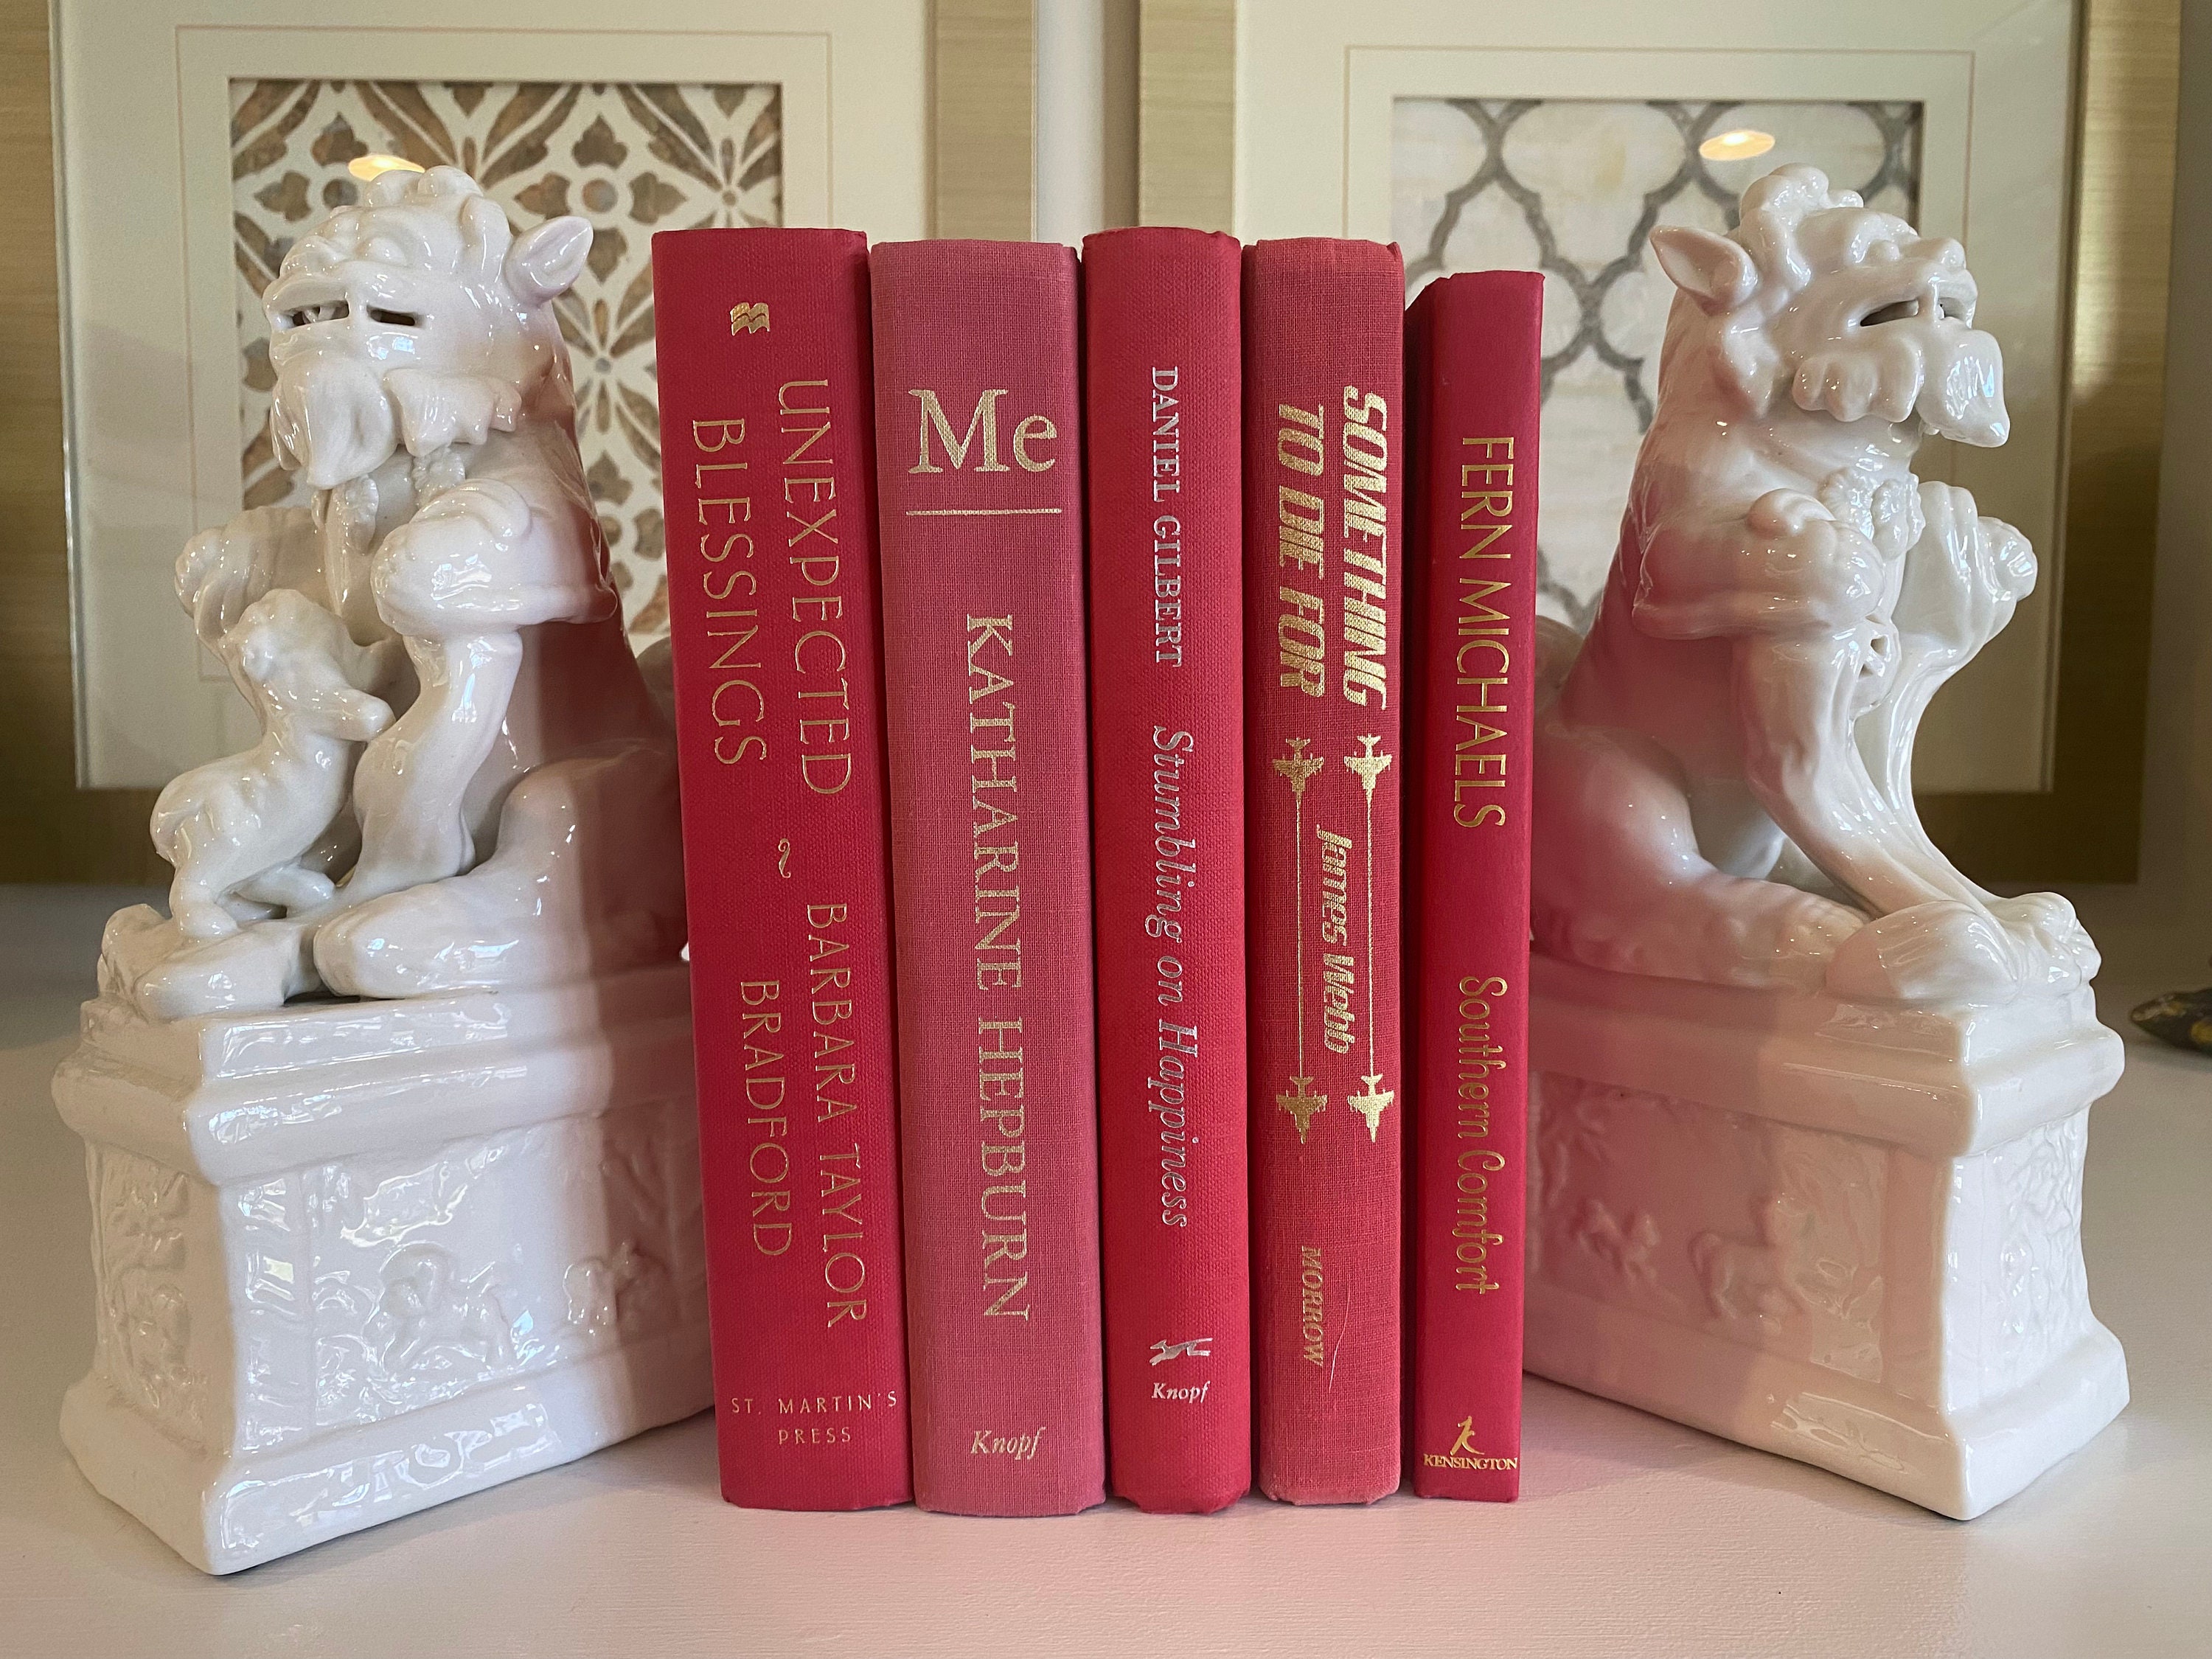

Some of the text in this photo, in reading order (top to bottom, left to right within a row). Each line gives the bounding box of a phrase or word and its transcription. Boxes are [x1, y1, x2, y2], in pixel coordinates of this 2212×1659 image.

[908, 389, 1057, 473] Me
[1152, 366, 1181, 667] DANIEL GILBERT
[1279, 404, 1324, 698] TO DIE FOR
[1343, 386, 1388, 710] SOMETHING
[693, 418, 767, 764] BLESSINGS
[779, 379, 851, 793] UNEXPECTED
[1454, 437, 1514, 827] FERN MICHAELS
[967, 613, 1029, 1321] KATHARINE HEPBURN
[1145, 726, 1199, 1227] Stumbling on Happiness
[1317, 824, 1354, 1054] James Webb
[741, 980, 792, 1256] BRADFORD
[807, 903, 866, 1328] BARBARA TAYLOR
[1453, 977, 1508, 1294] Southern Comfort
[732, 1391, 897, 1415] ST. MARTIN'S
[779, 1427, 850, 1444] PRESS
[971, 1427, 1046, 1460] Knopf
[1152, 1381, 1210, 1403] Knopf
[1302, 1245, 1324, 1368] MORROW
[1424, 1455, 1517, 1470] KENSINGTON
